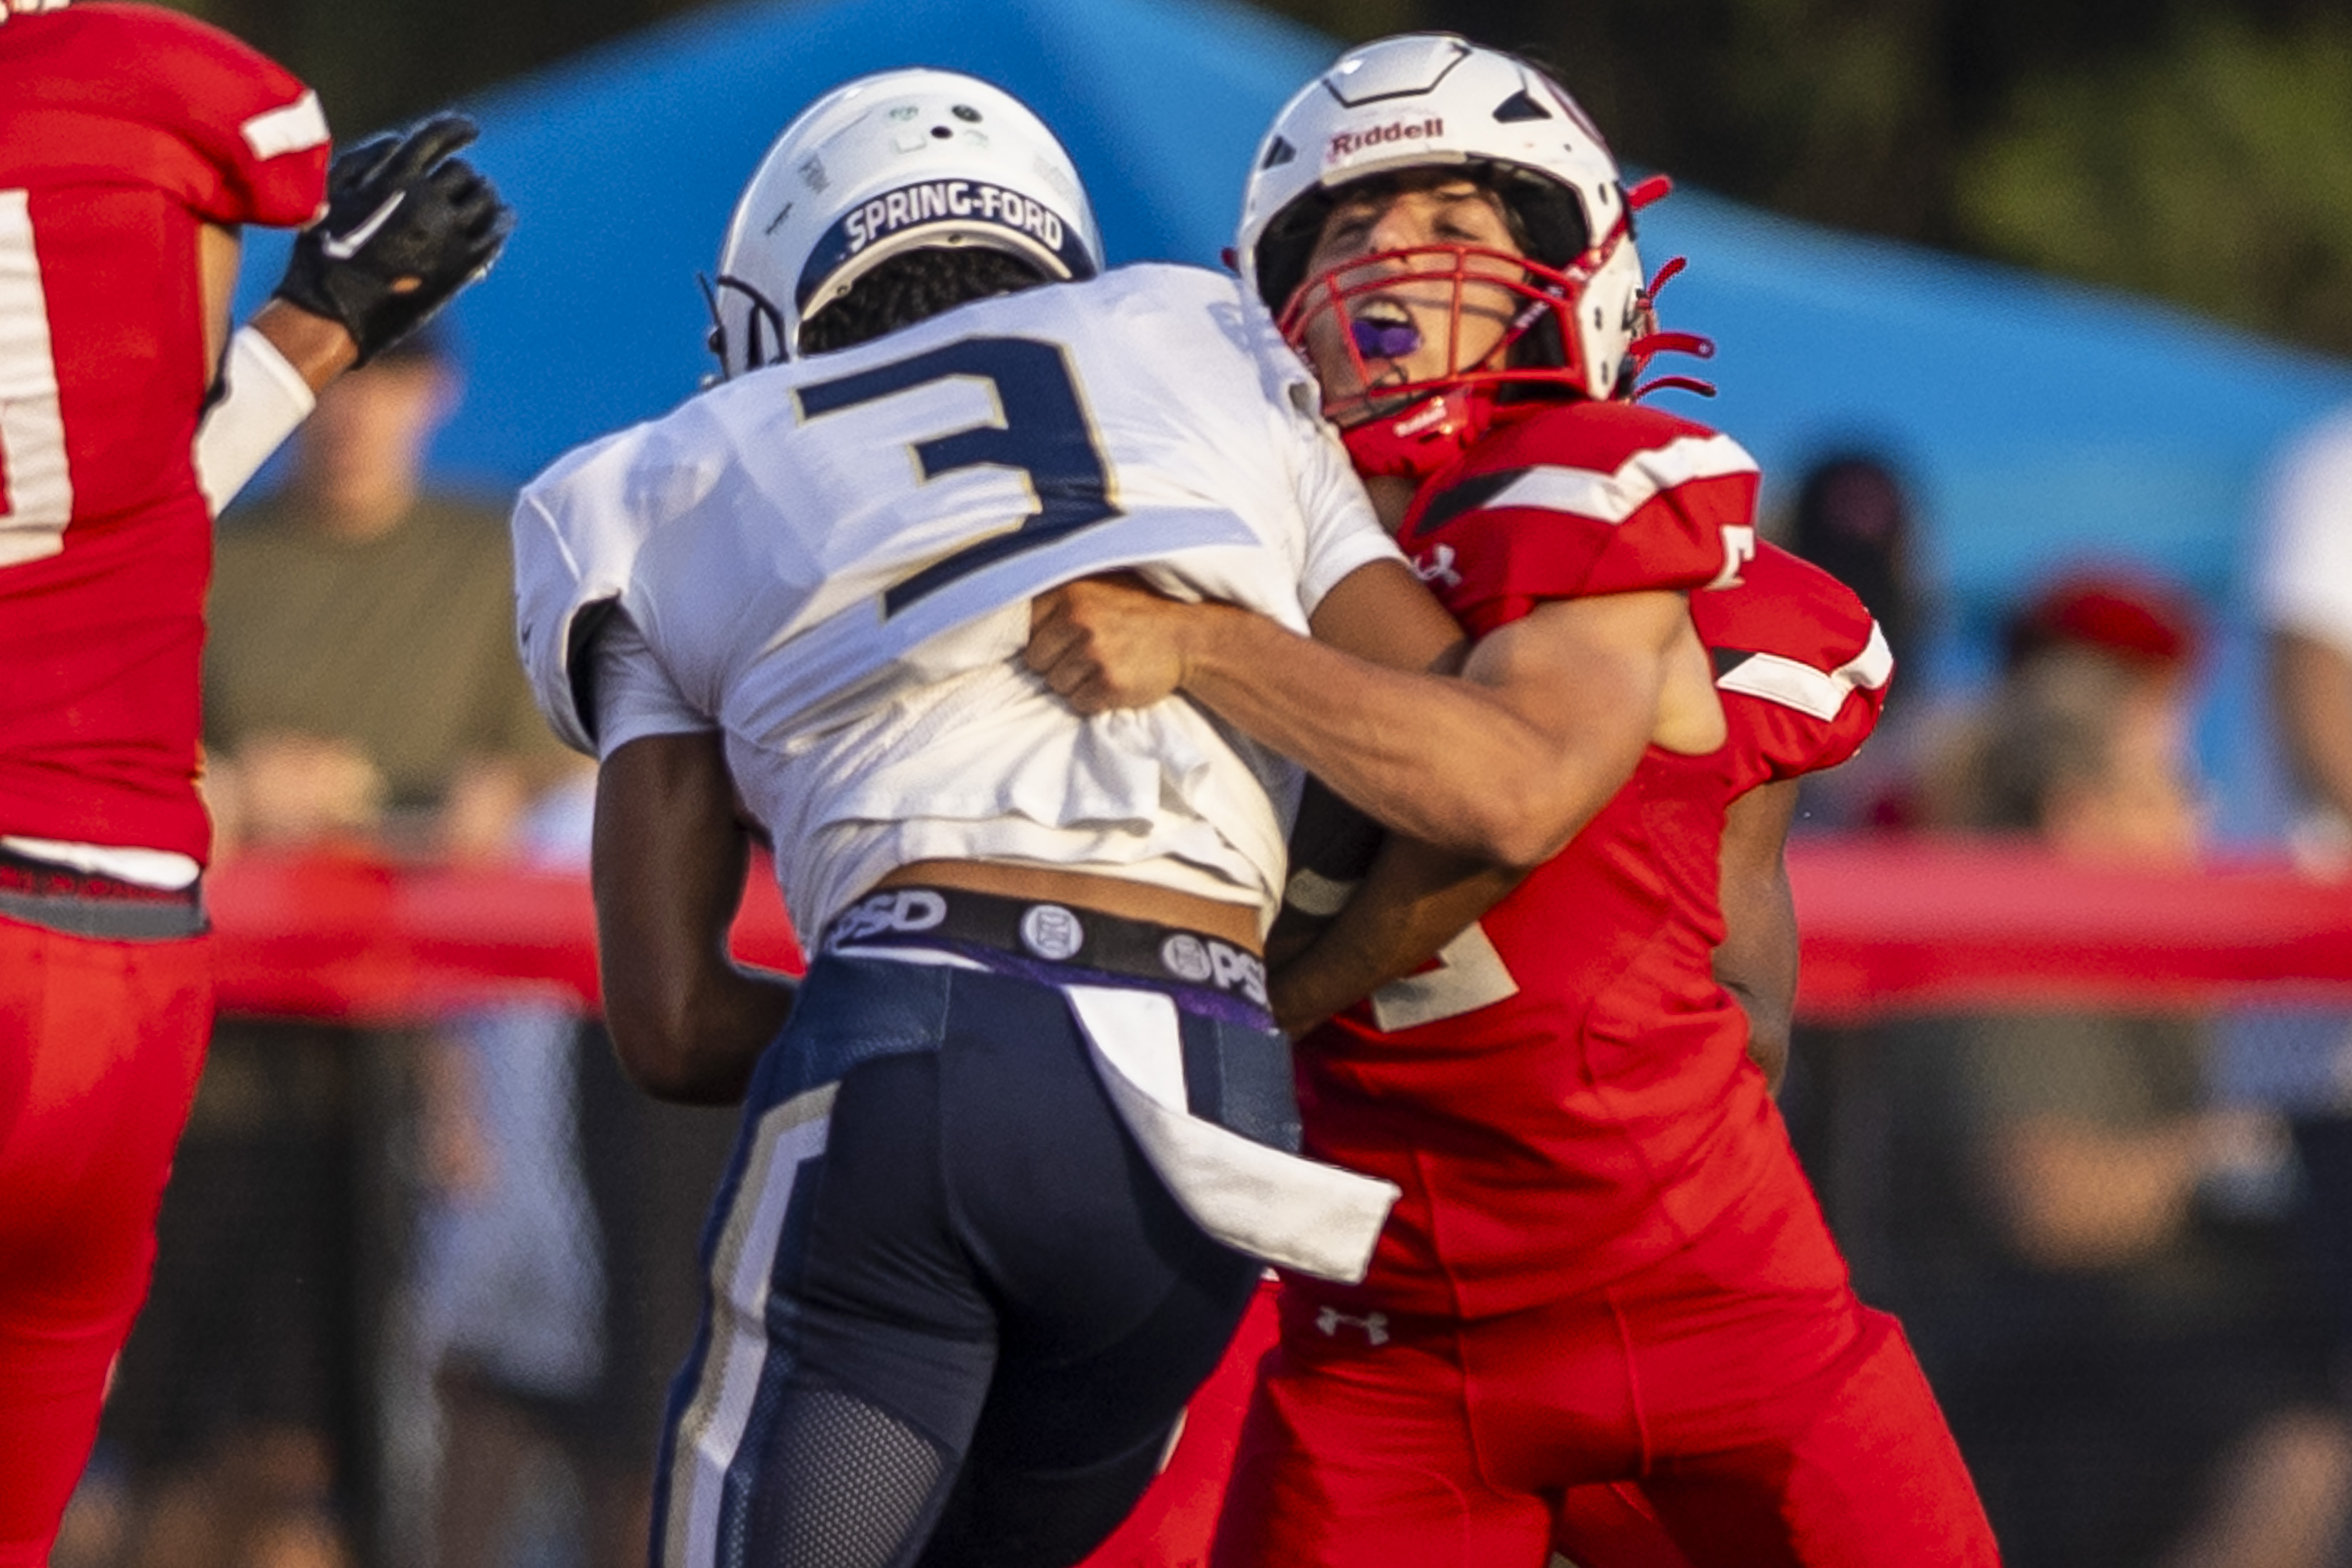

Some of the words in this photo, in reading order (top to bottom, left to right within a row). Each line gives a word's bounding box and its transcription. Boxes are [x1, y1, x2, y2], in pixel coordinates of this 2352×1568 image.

[1331, 118, 1443, 155] Riddell
[846, 182, 1063, 252] SPRING-FORD
[791, 335, 1127, 624] 3
[1208, 940, 1267, 1006] PS
